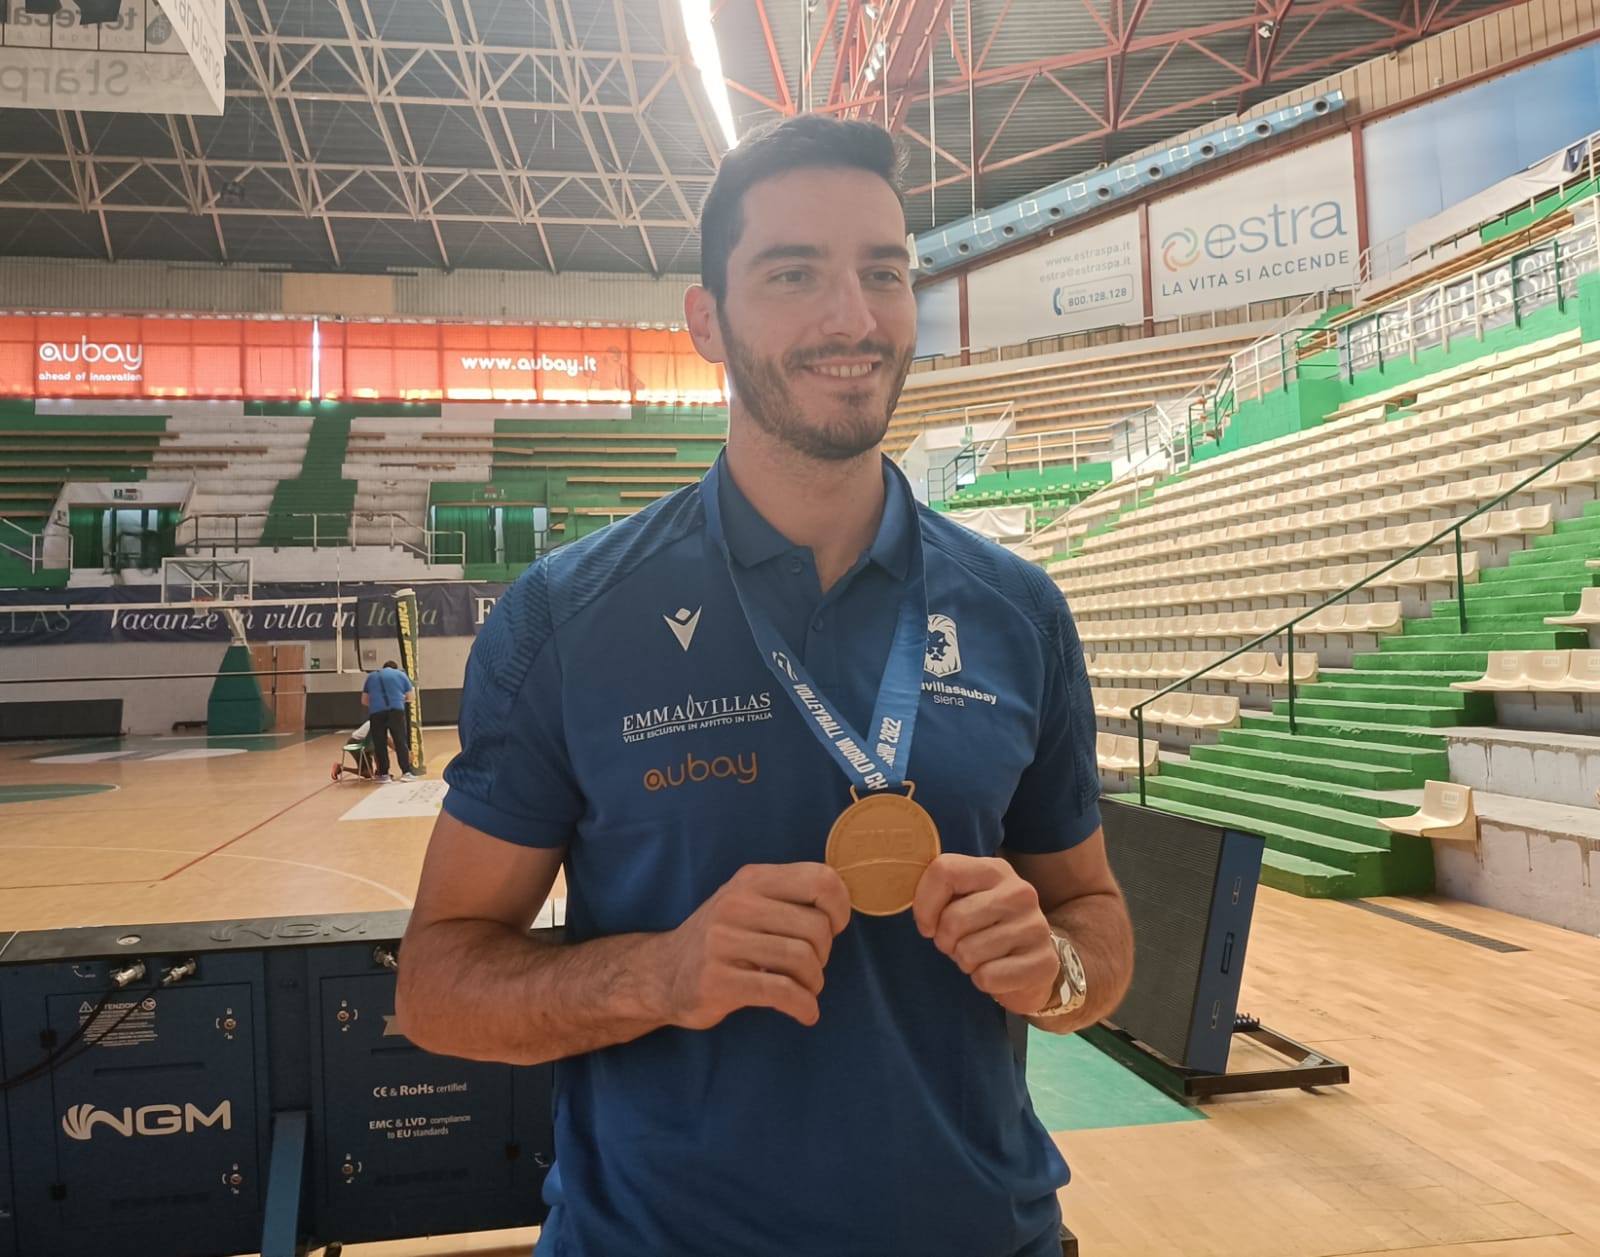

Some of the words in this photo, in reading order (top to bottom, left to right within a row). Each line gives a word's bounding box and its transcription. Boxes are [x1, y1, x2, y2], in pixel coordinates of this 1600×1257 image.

[1204, 201, 1348, 259] estra
[1045, 241, 1131, 267] www.estraspa.it
[1040, 257, 1131, 283] estra@estraspa.it
[1162, 282, 1183, 297] LA
[1189, 273, 1228, 291] VITA
[1235, 267, 1250, 284] SI
[1259, 250, 1350, 280] ACCENDE
[1068, 287, 1127, 307] 800.128.128
[39, 334, 143, 371] aubay
[461, 354, 597, 377] www.aubay.it
[38, 371, 72, 381] ahead
[75, 371, 86, 381] of
[89, 372, 143, 382] innovation
[264, 604, 323, 630] villa
[622, 705, 686, 732] EMMA
[694, 692, 771, 717] VILLAS
[933, 693, 965, 707] siena
[623, 733, 645, 743] VILLE
[688, 722, 698, 731] IN
[699, 717, 732, 729] AFFITTO
[735, 715, 745, 724] IN
[747, 712, 773, 722] ITALIA
[792, 683, 845, 739] VOLLEYBALL
[835, 736, 876, 774] WORLD
[878, 716, 902, 744] 2022
[643, 752, 758, 792] aubay
[373, 1086, 388, 1098] CE
[389, 1088, 397, 1097] &
[400, 1083, 434, 1096] RoHs
[436, 1082, 467, 1093] certified
[62, 1100, 232, 1141] NGM
[369, 1119, 393, 1130] EMC
[394, 1118, 402, 1128] &
[405, 1117, 427, 1127] LVD
[387, 1131, 395, 1139] to
[396, 1129, 411, 1138] EU
[412, 1126, 449, 1137] standards
